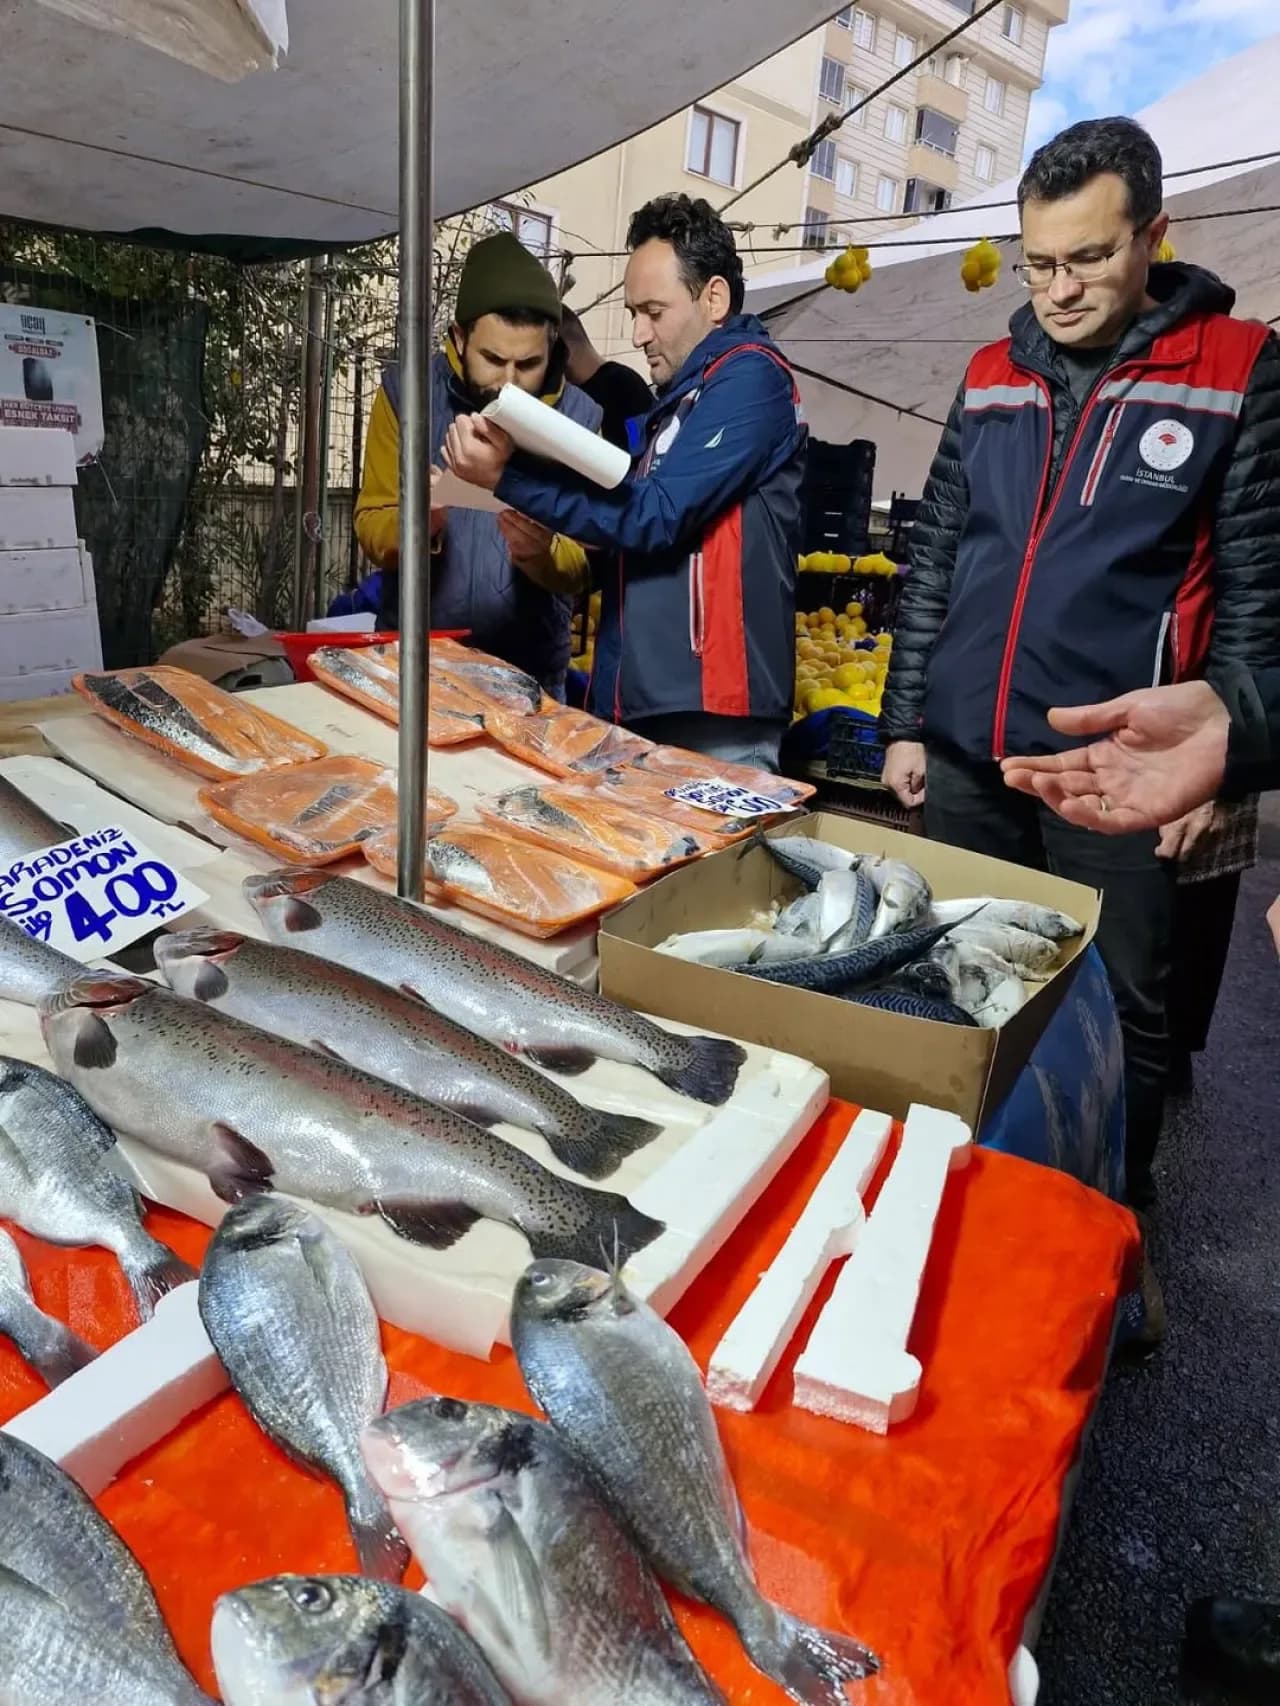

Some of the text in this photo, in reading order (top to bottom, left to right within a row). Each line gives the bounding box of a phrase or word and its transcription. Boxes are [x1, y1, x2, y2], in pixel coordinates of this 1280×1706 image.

[0, 828, 123, 893] ARADENİZ
[0, 840, 138, 917] SOMON
[65, 861, 177, 942] 400
[151, 901, 185, 918] TL
